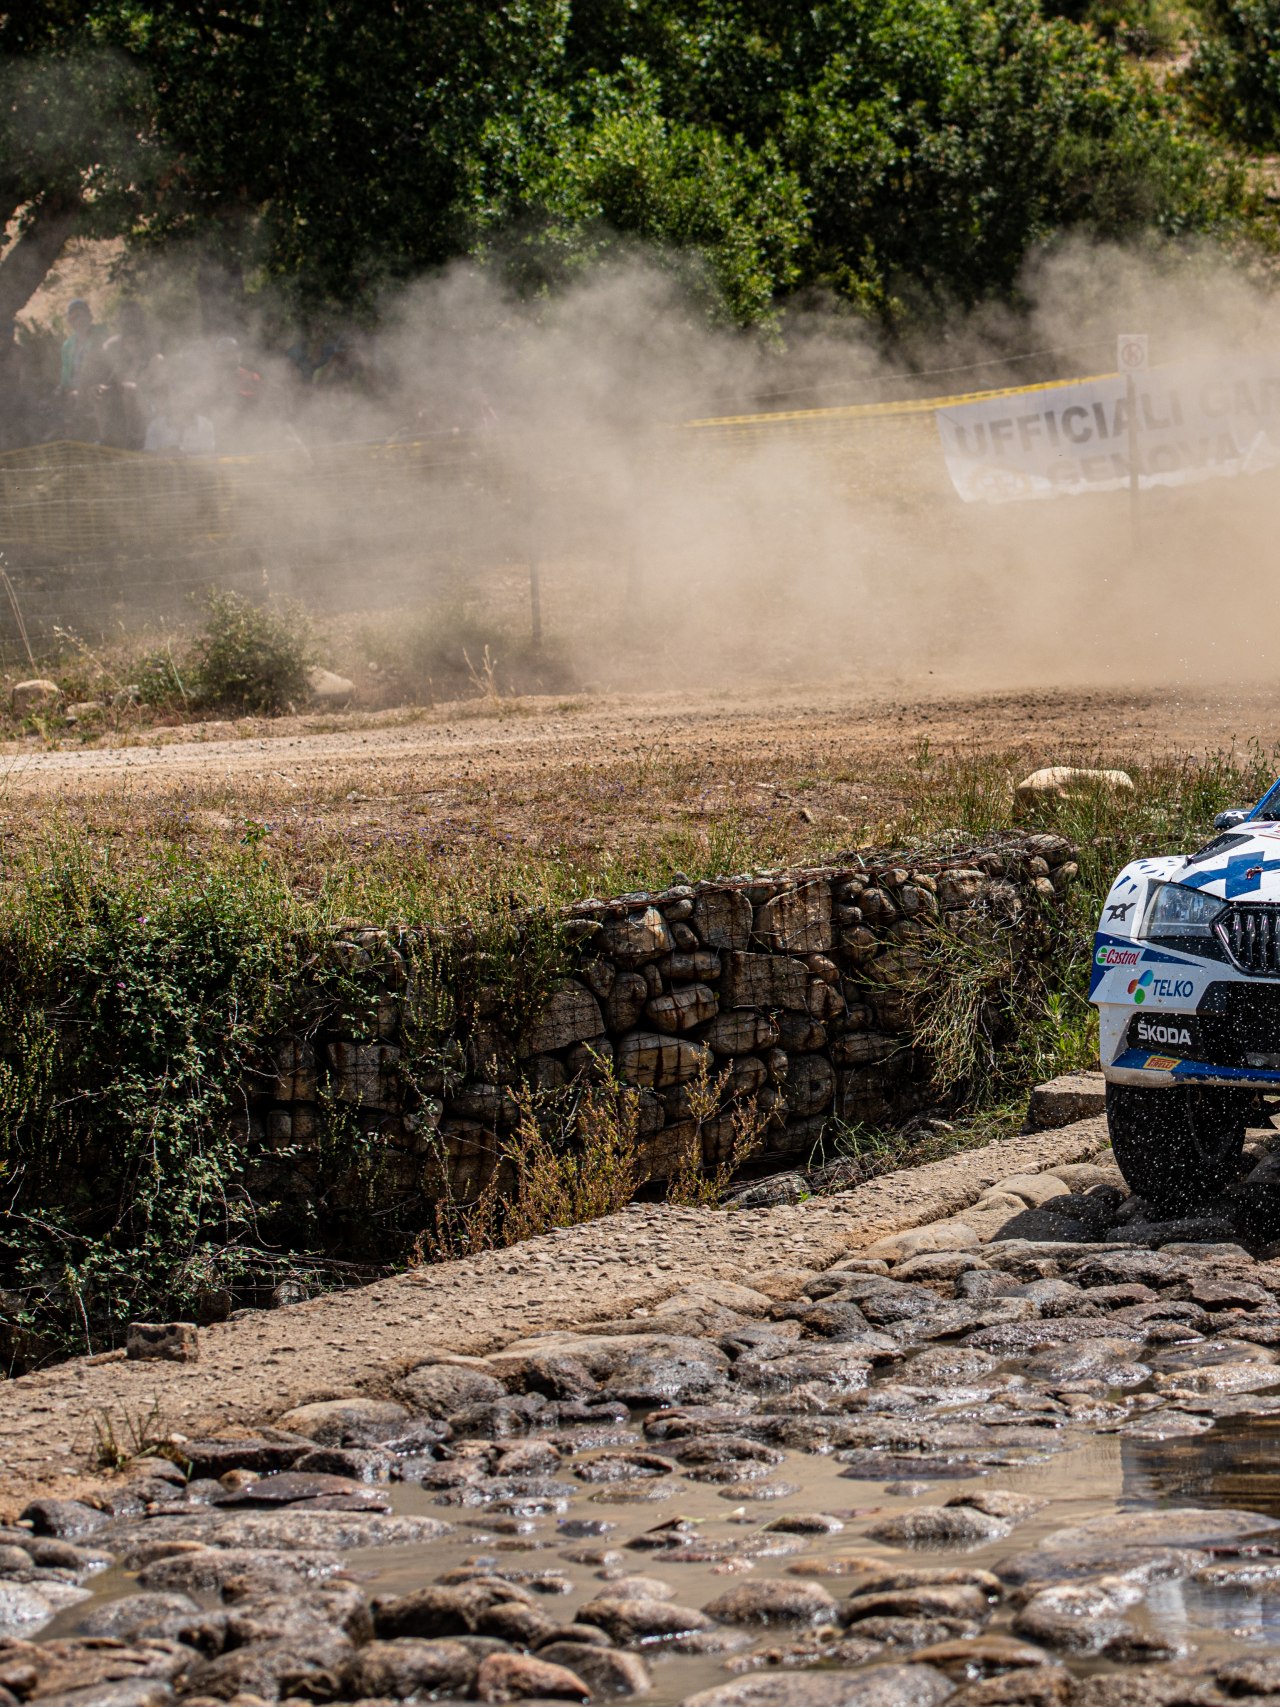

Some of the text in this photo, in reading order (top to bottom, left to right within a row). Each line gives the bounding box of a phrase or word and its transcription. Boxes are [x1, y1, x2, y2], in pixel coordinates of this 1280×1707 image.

[955, 389, 1184, 459] UFFICIALI
[1105, 949, 1140, 966] Castrol
[1153, 979, 1193, 998] TELKO
[1137, 1021, 1192, 1045] ŠKODA
